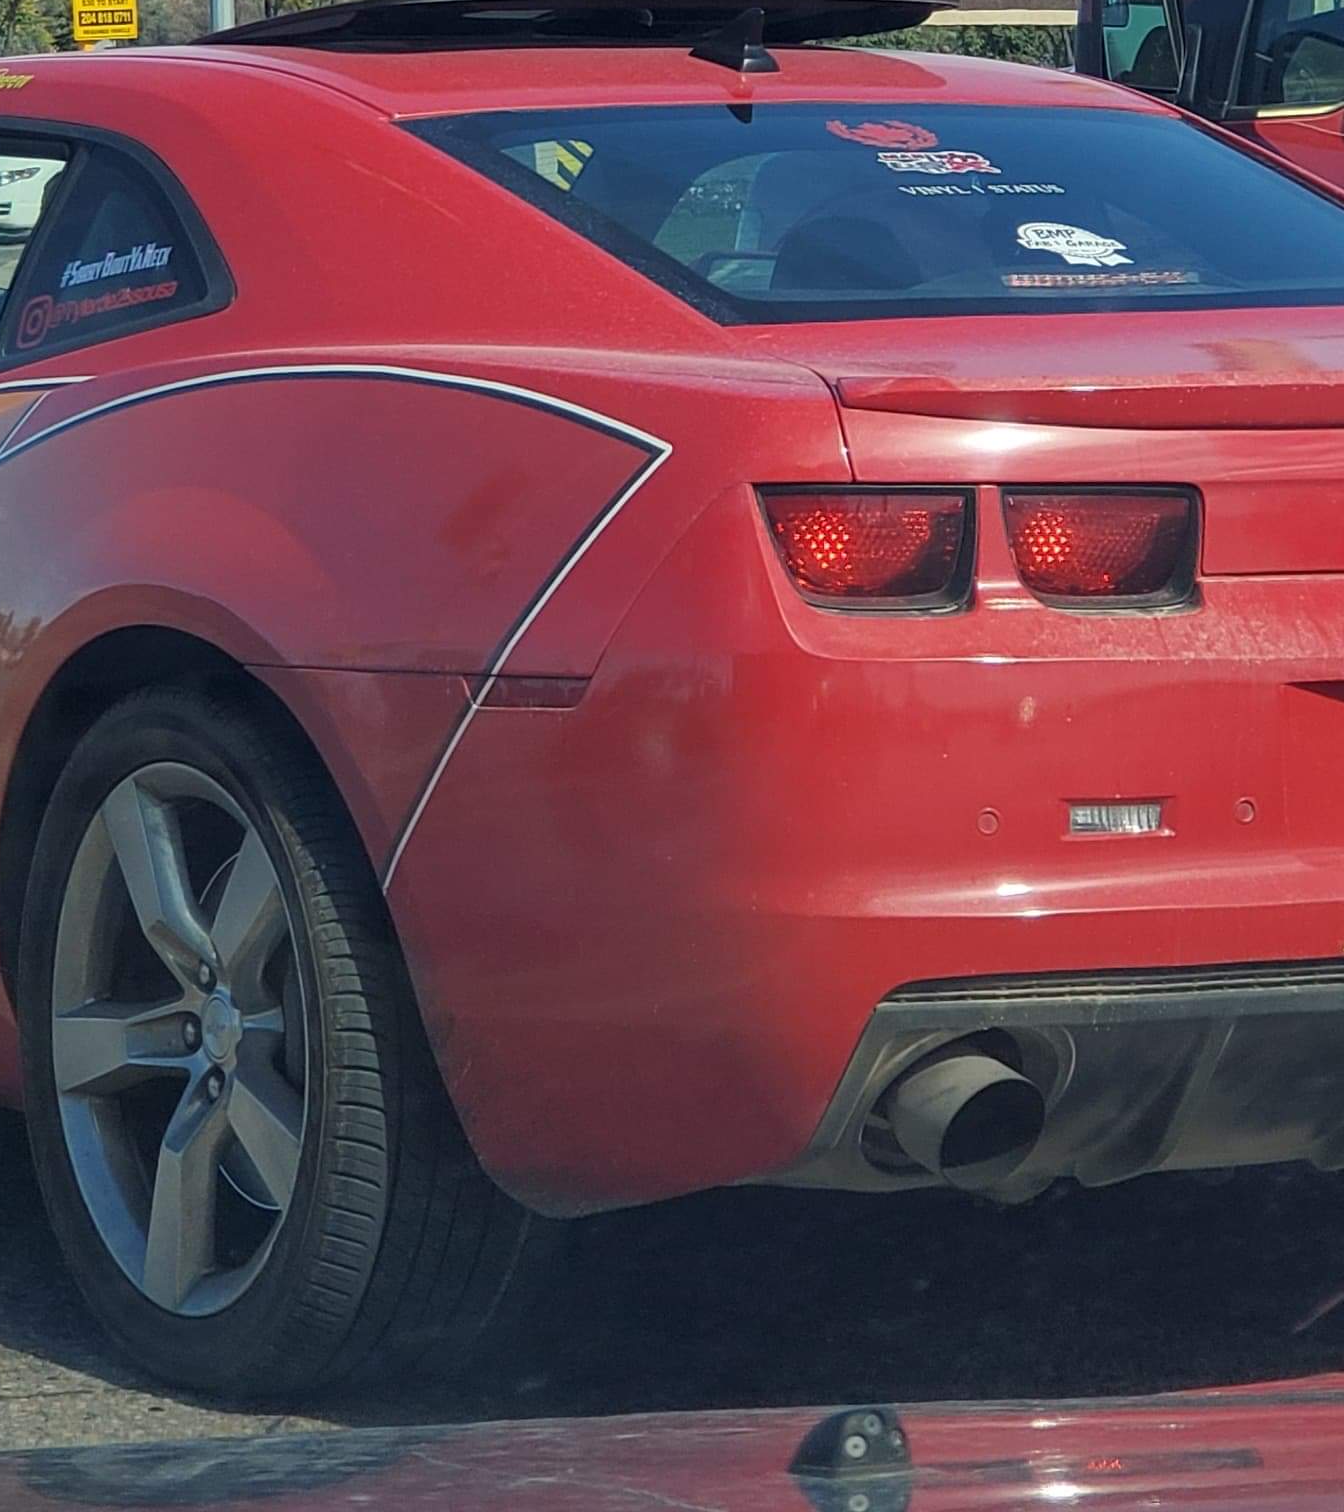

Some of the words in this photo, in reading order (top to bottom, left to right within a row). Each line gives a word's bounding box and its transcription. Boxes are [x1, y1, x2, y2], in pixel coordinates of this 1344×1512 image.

[80, 12, 96, 25] 204
[898, 185, 972, 196] VINYL
[987, 184, 1066, 194] STATUS
[1032, 228, 1076, 240] BMP
